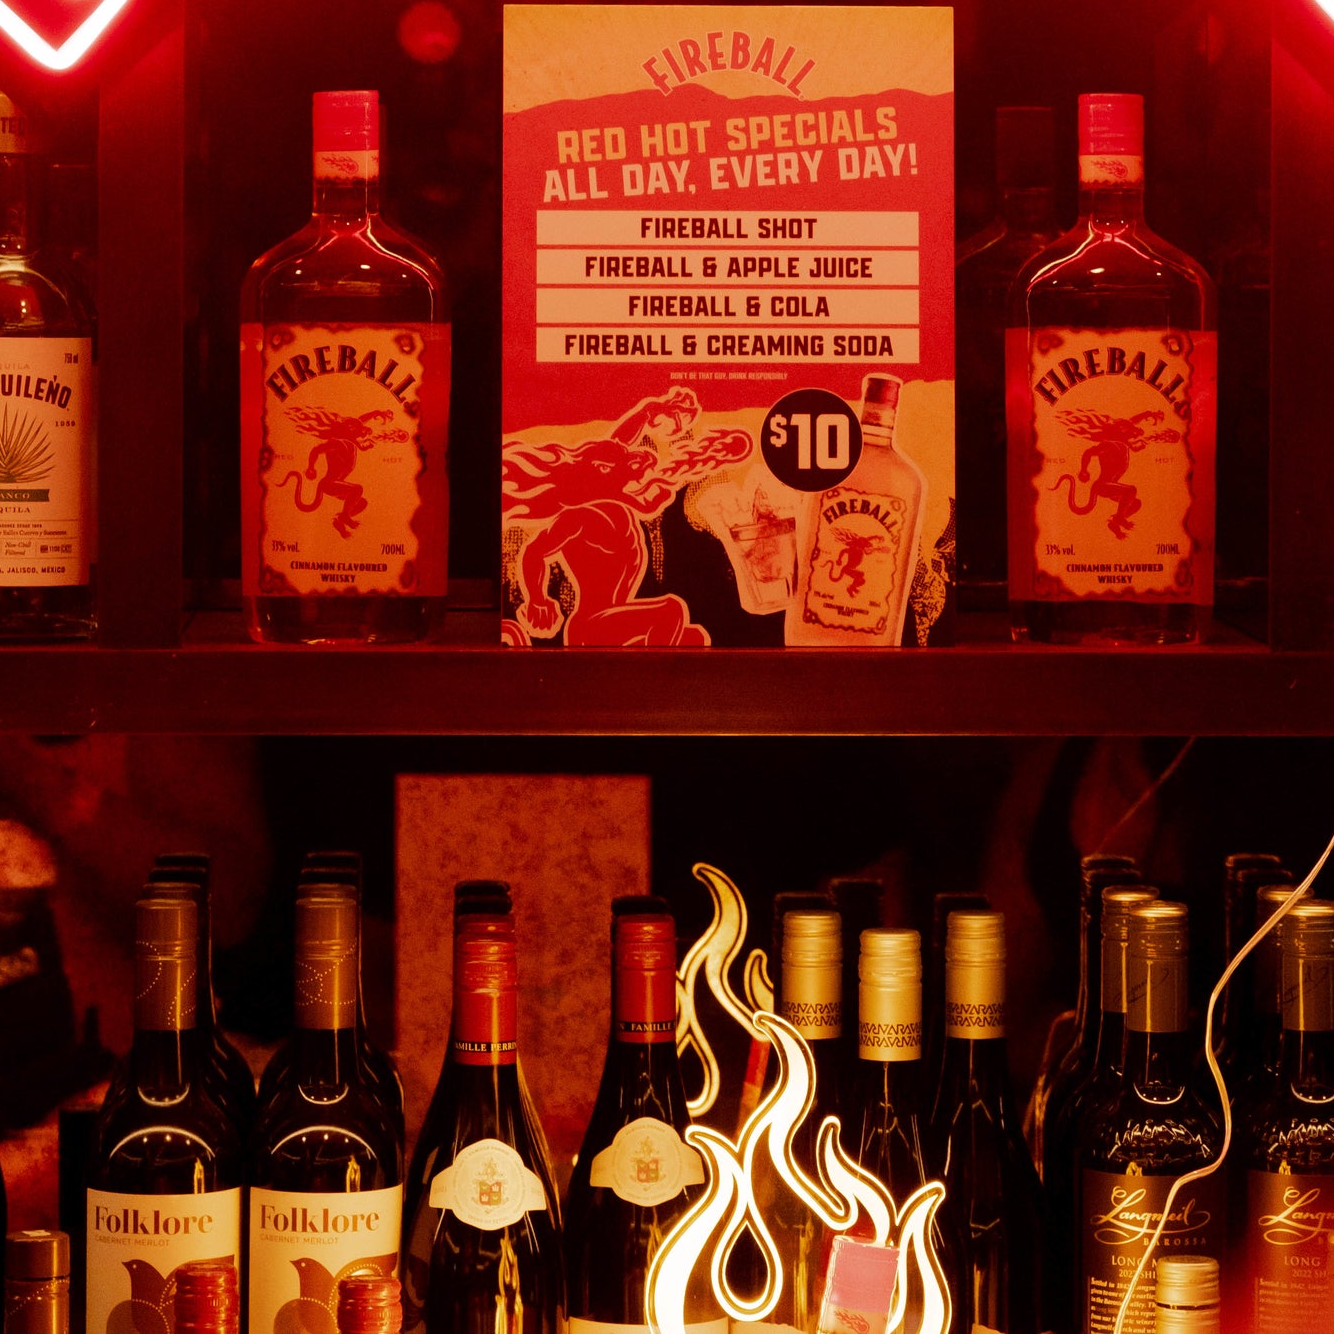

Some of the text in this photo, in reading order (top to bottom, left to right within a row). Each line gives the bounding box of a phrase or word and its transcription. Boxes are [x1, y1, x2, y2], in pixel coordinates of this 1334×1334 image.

[641, 31, 816, 100] FIREBALL
[557, 106, 898, 163] RED HOT SPECIALS
[543, 142, 920, 203] ALL DAY, EVERY DAY!
[640, 217, 817, 239] FIREBALL SHOT
[585, 256, 873, 279] FIREBALL & APPLE JUICE
[628, 295, 830, 317] FIREBALL & COLA
[564, 333, 893, 356] FIREBALL & CREAMING SODA
[266, 344, 416, 403] FIREBALL
[670, 372, 687, 380] DON'T
[689, 372, 697, 380] BE
[699, 372, 713, 380] THAT
[748, 372, 788, 380] RESPONSIBLY
[1034, 346, 1185, 407] FIREBALL
[769, 413, 850, 470] $10
[822, 498, 898, 533] FIREBALL
[271, 539, 286, 553] 33%
[381, 542, 406, 555] 700ML
[1045, 542, 1061, 555] 33%
[1155, 543, 1181, 556] 700ML
[290, 560, 388, 573] CINNAMON FLAVOURED
[1066, 562, 1164, 574] CINNAMON FLAVOURED
[320, 572, 356, 584] WHISKY
[1097, 574, 1133, 585] WHISKY
[630, 1022, 672, 1032] FAMILLE
[94, 1204, 213, 1235] Folklore
[260, 1204, 379, 1234] Folklore
[1090, 1186, 1211, 1245] Langmeil
[94, 1234, 170, 1246] CABERNET MERLOT
[260, 1233, 339, 1245] CABERNET MERLOT
[1143, 1237, 1208, 1246] BAROSSA
[1284, 1256, 1321, 1267] LONG
